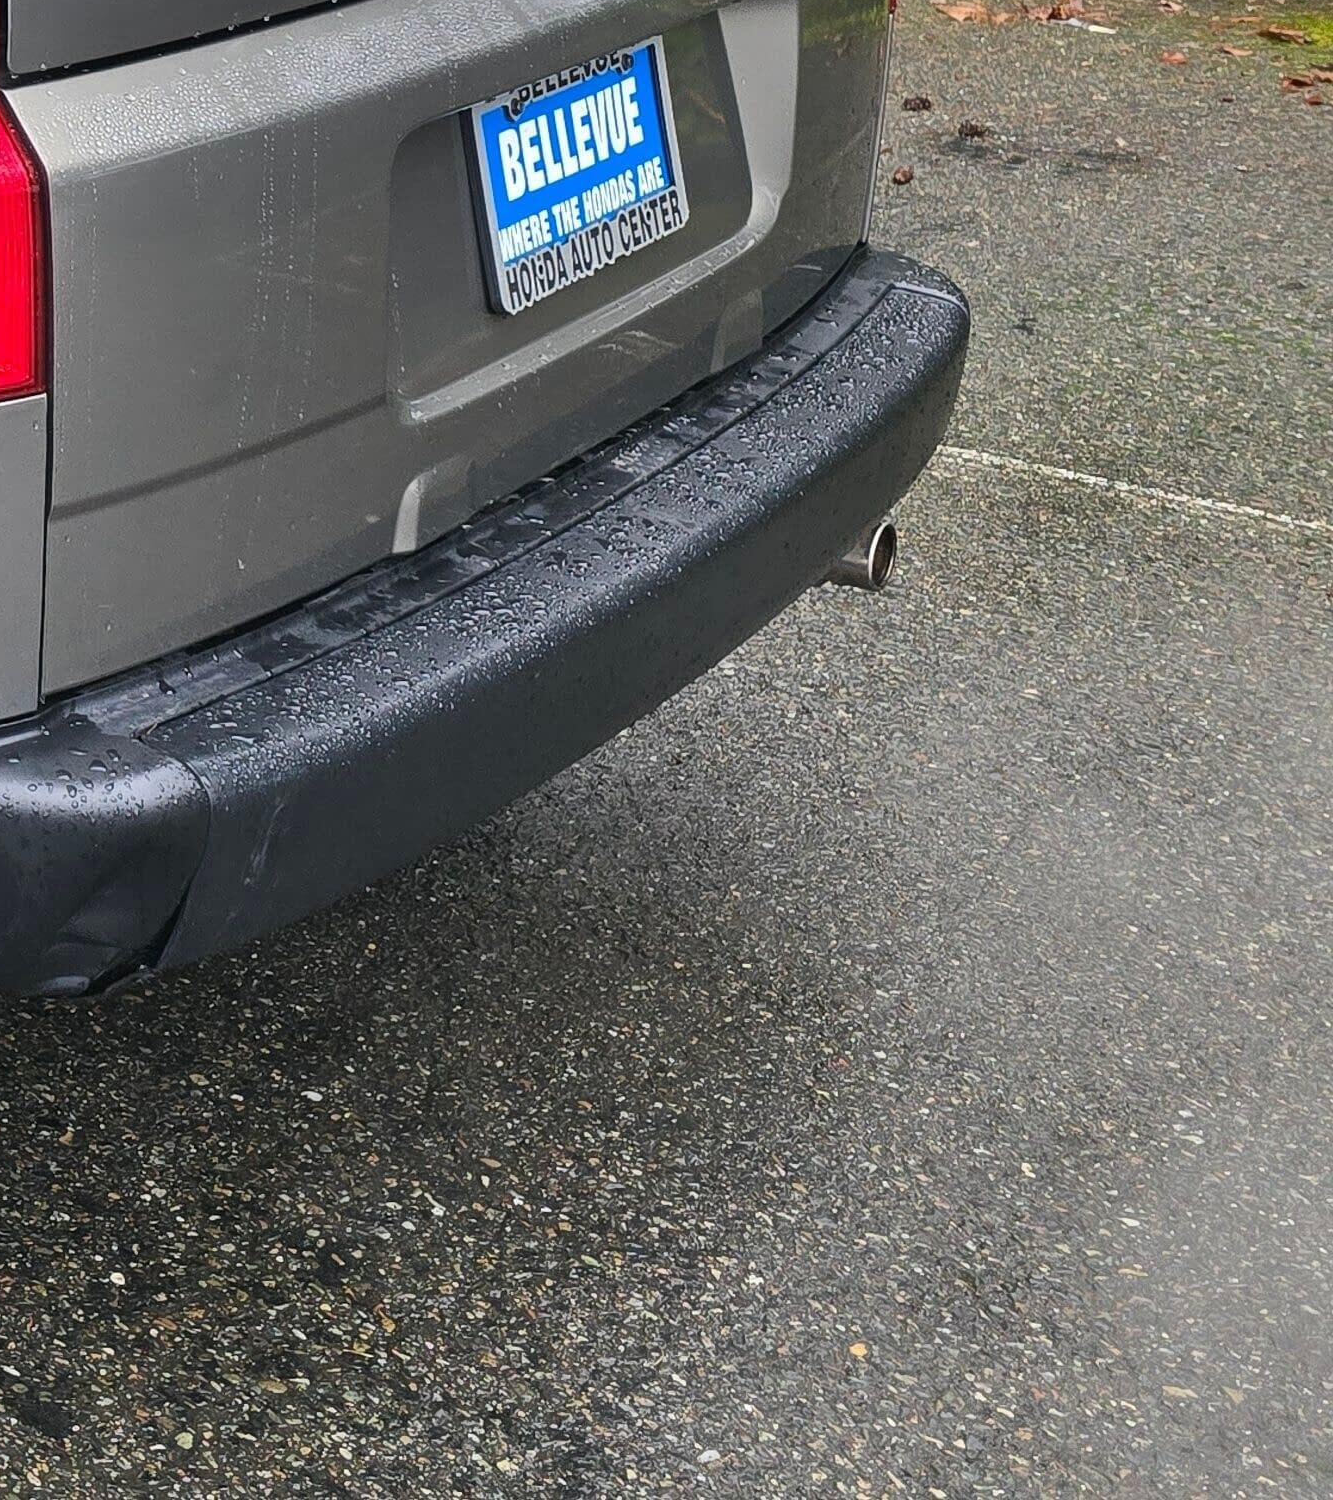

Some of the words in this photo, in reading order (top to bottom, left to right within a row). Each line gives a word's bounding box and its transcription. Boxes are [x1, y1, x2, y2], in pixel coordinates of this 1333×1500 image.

[497, 75, 645, 202] BELLEVUE
[498, 209, 553, 263] WHERE
[551, 195, 582, 237] THE
[582, 169, 637, 224] HONDAS
[637, 155, 665, 197] ARE
[506, 246, 569, 310] HONDA
[568, 220, 615, 278] AUTO
[619, 189, 684, 251] CENTER
